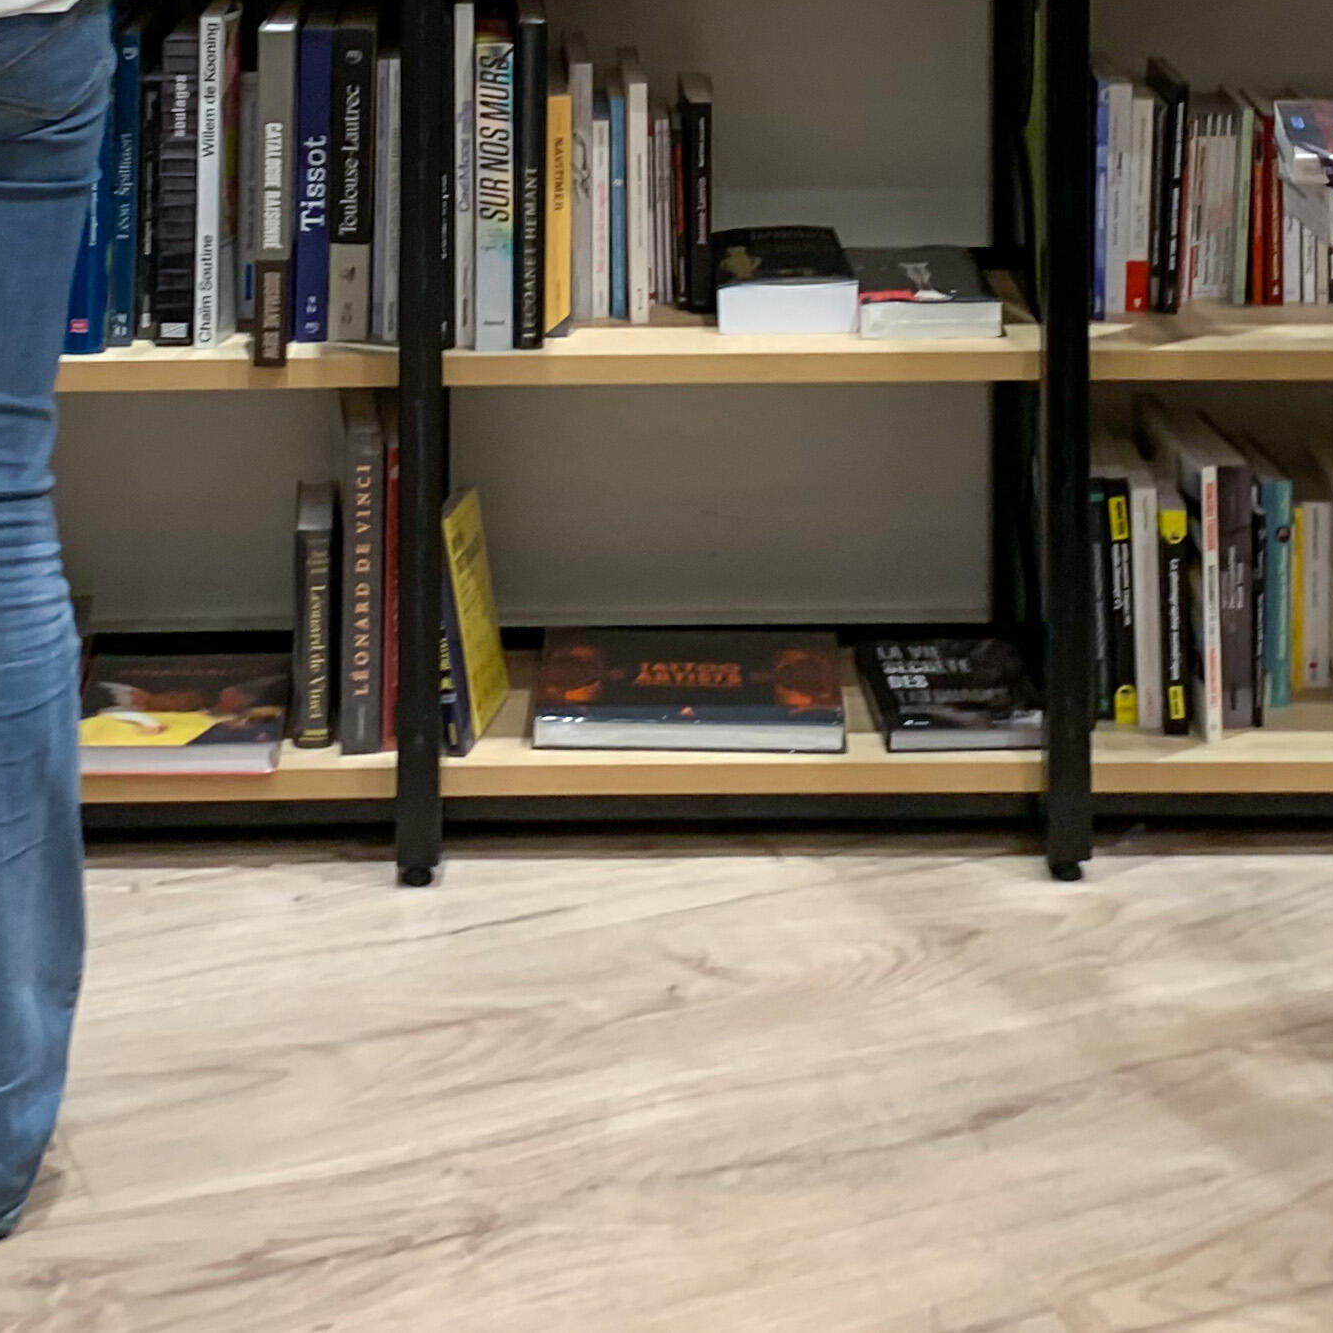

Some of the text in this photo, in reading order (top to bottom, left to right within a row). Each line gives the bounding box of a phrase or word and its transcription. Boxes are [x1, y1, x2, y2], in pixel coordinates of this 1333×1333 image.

[201, 22, 219, 158] Willem de Kooning
[478, 54, 511, 223] SUR NOS MURS
[264, 122, 282, 188] CATALOGUE
[300, 135, 327, 232] Tissot
[338, 84, 361, 236] Toulouse-Lautrec
[523, 167, 538, 241] HEMANT
[198, 234, 213, 344] Chaïm Soutine
[351, 464, 372, 697] LÉONARD DE VINCI
